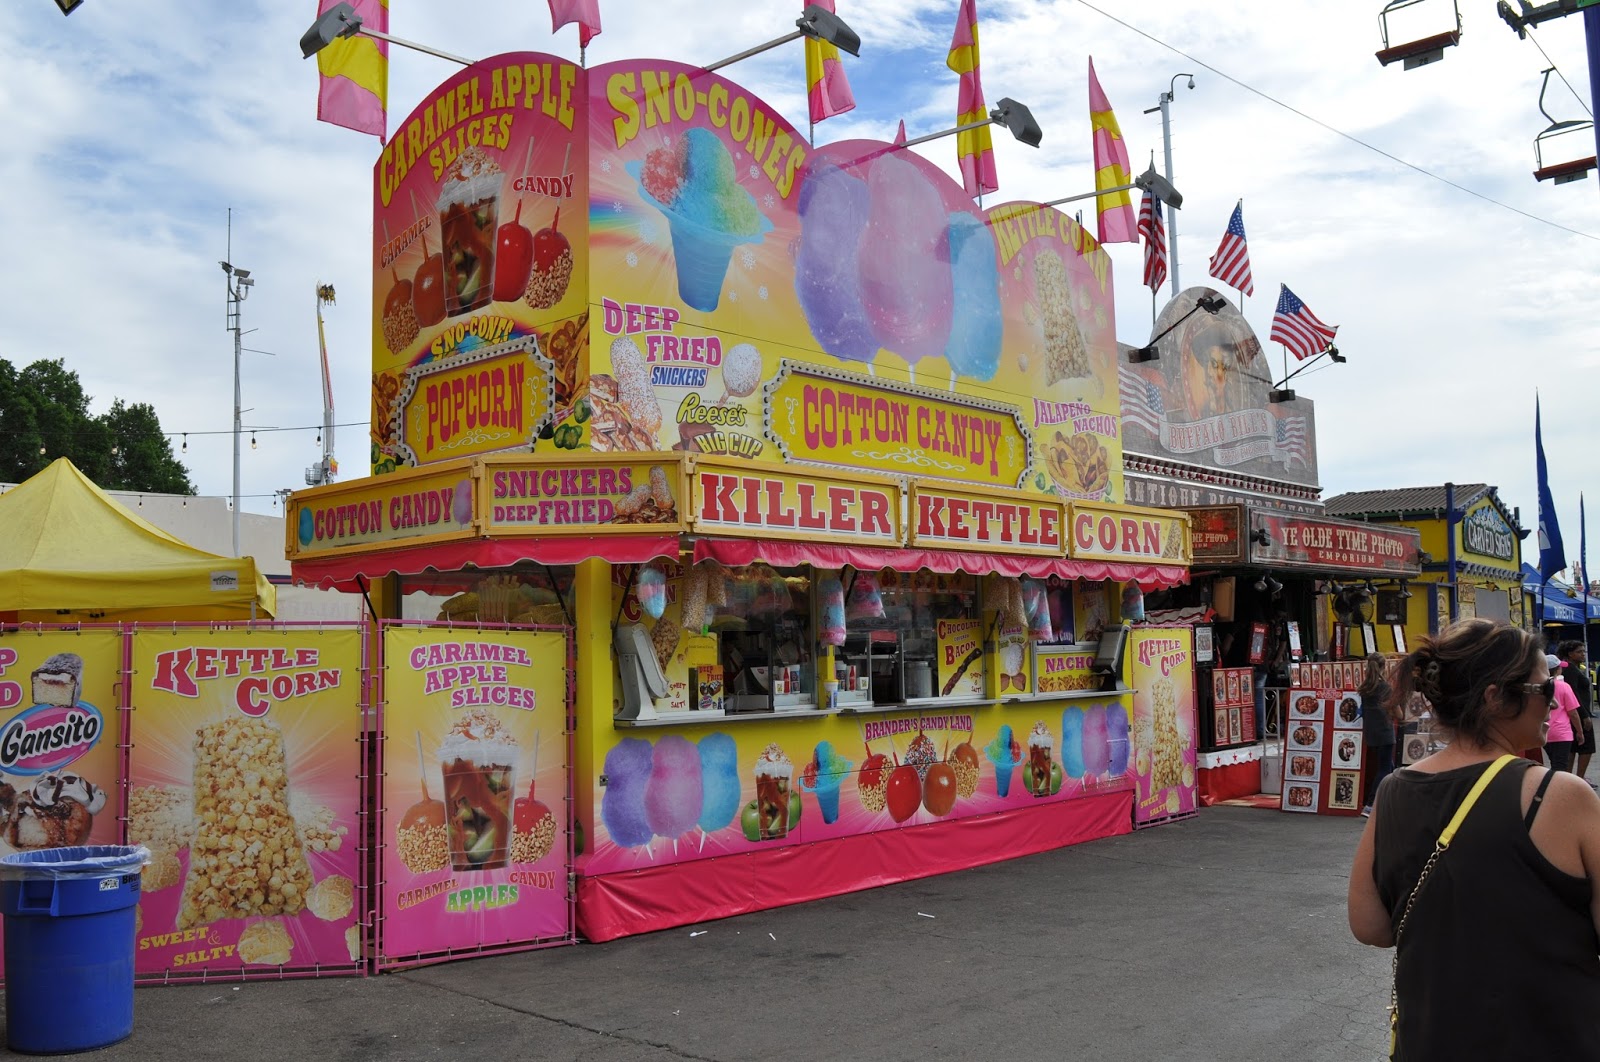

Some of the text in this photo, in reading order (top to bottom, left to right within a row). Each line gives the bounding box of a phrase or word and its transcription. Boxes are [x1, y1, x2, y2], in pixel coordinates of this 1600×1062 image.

[380, 63, 576, 208] CARAMEL APPLE
[429, 113, 514, 183] SLICES
[606, 70, 806, 199] SNO-CONES
[512, 173, 574, 198] CANDY
[380, 215, 432, 269] CARAMEL
[988, 204, 1057, 267] KETTLE
[602, 297, 680, 335] DEEP
[645, 334, 722, 367] FRIED
[651, 366, 708, 387] SNICKERS
[426, 361, 525, 454] POPCORN
[676, 392, 748, 427] Reese's
[803, 384, 1002, 477] COTTON CANDY
[1073, 415, 1117, 439] NACHOS
[694, 431, 764, 459] BIG CUP
[493, 467, 632, 497] SNICKERS
[313, 487, 454, 541] COTTON CANDY
[493, 499, 614, 524] DEEP FRIED
[701, 472, 1161, 556] KILLER KETTLE CORN
[1205, 532, 1228, 543] PHOTO
[1280, 527, 1404, 557] YE OLDE TYME PHOTO
[1318, 550, 1375, 564] EMPORIUM
[938, 620, 980, 640] CHOCOLATE
[410, 642, 532, 671] CARAMEL
[944, 640, 976, 666] BACON
[1045, 656, 1096, 674] NACHO
[1138, 639, 1181, 667] KETTLE
[1160, 651, 1186, 677] CORN
[152, 647, 319, 698] KETTLE
[424, 665, 508, 695] APPLE
[235, 669, 341, 718] CORN
[451, 685, 536, 710] SLICES
[1, 712, 98, 765] Gansito
[865, 715, 973, 740] BRANDER'S CANDY LAND
[397, 878, 459, 910] CARAMEL
[509, 871, 556, 890] CANDY
[446, 884, 518, 913] APPLES
[139, 926, 222, 950] SWEET &
[173, 944, 236, 967] SALTY
